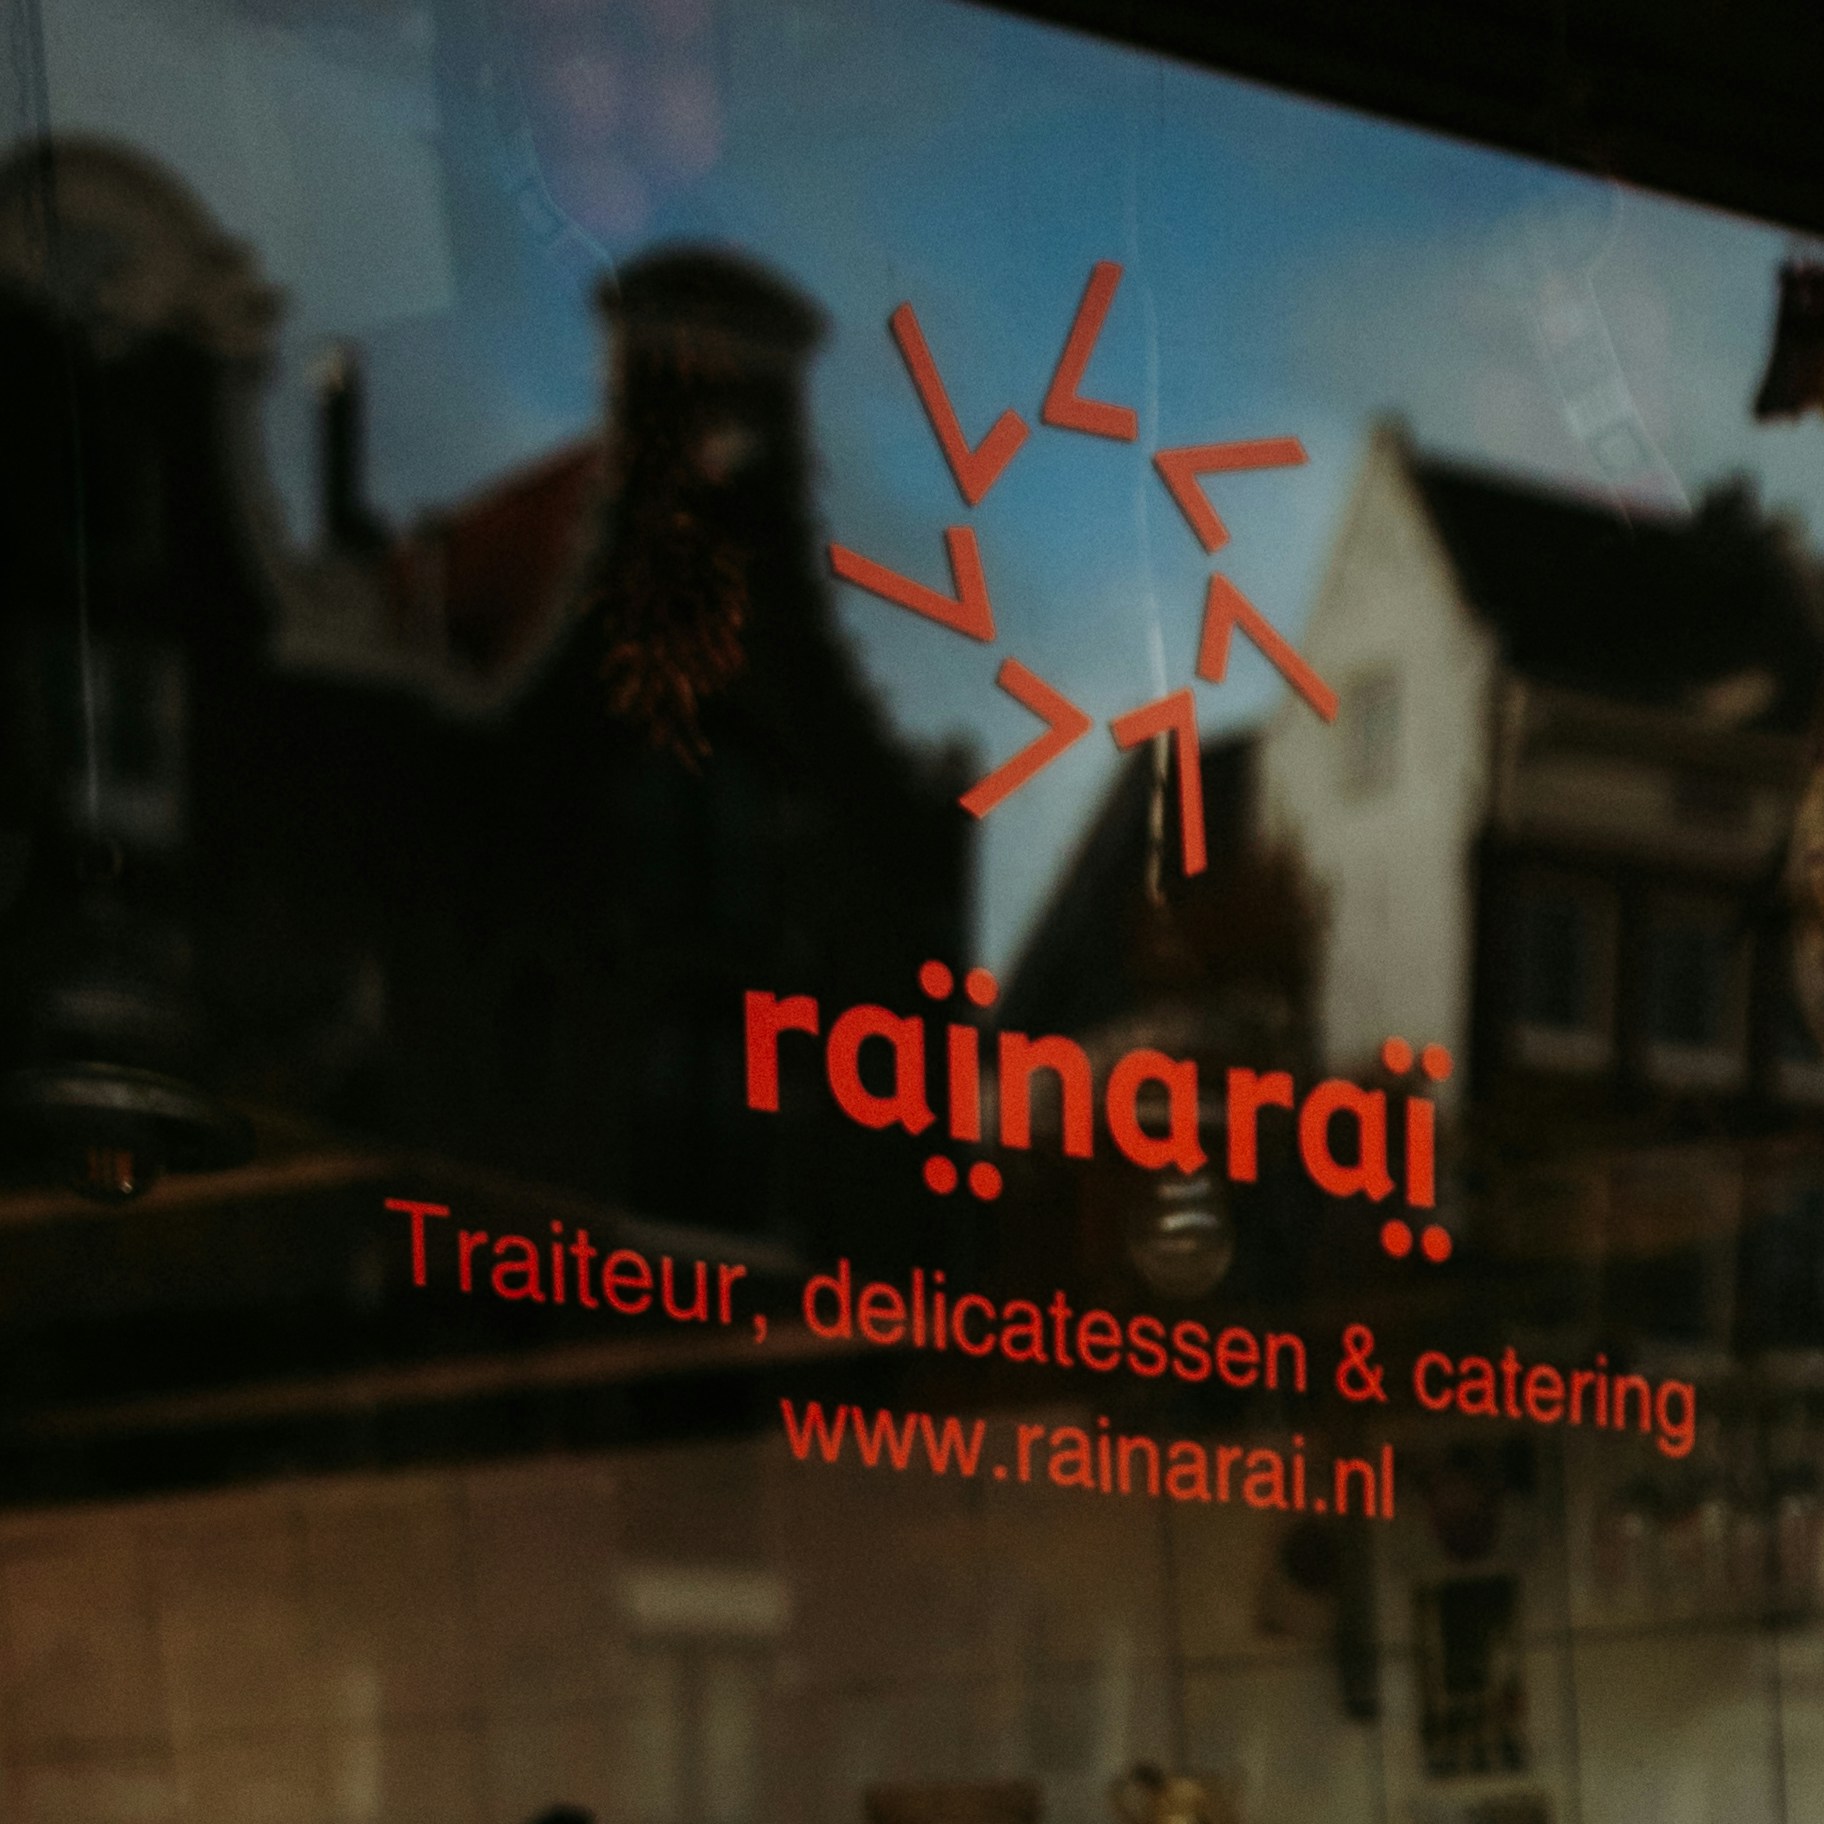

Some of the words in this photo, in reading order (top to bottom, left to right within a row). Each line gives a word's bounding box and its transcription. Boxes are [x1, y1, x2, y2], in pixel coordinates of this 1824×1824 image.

[384, 1198, 768, 1344] Traiteur,
[803, 1258, 1308, 1393] delicatessen
[1335, 1323, 1387, 1403] &
[1413, 1349, 1695, 1458] catering
[780, 1398, 1395, 1520] www.rainarai.nl
